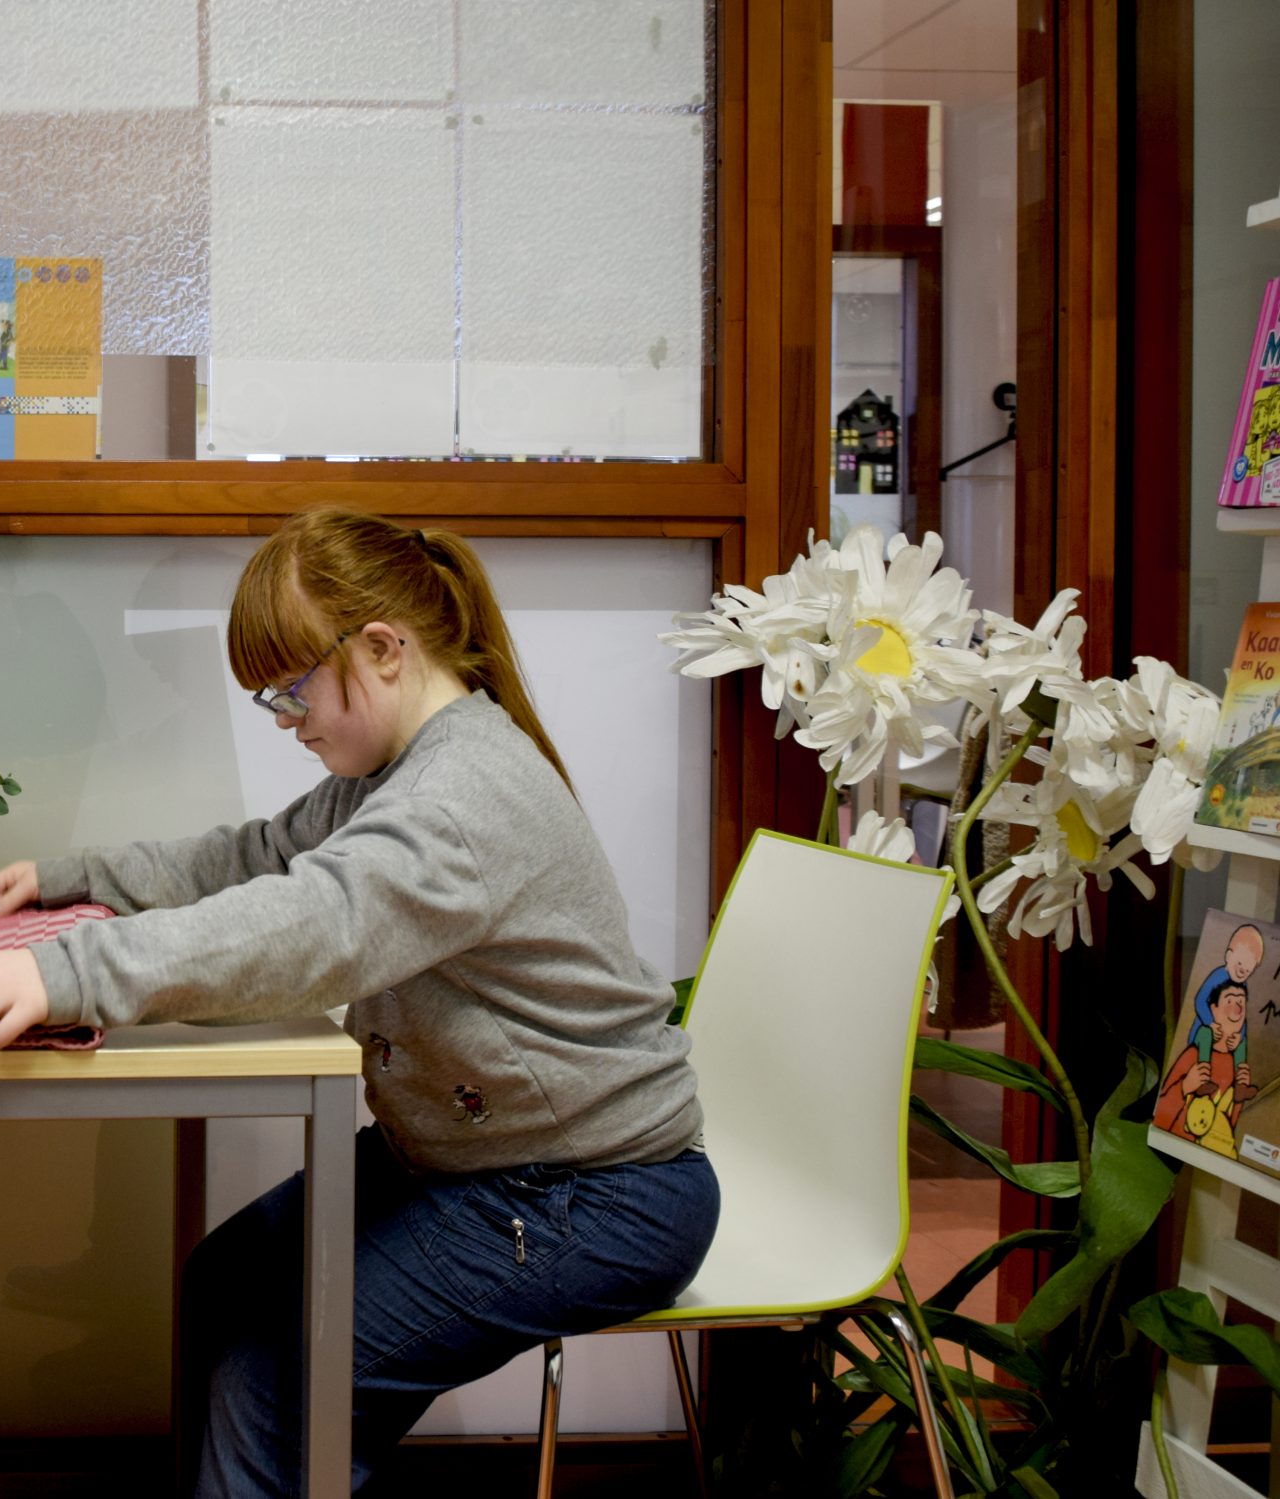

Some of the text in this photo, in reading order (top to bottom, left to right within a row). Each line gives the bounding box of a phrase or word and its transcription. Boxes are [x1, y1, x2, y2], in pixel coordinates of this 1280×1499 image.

[1245, 631, 1280, 652] Kaa
[1241, 660, 1275, 680] en Ko
